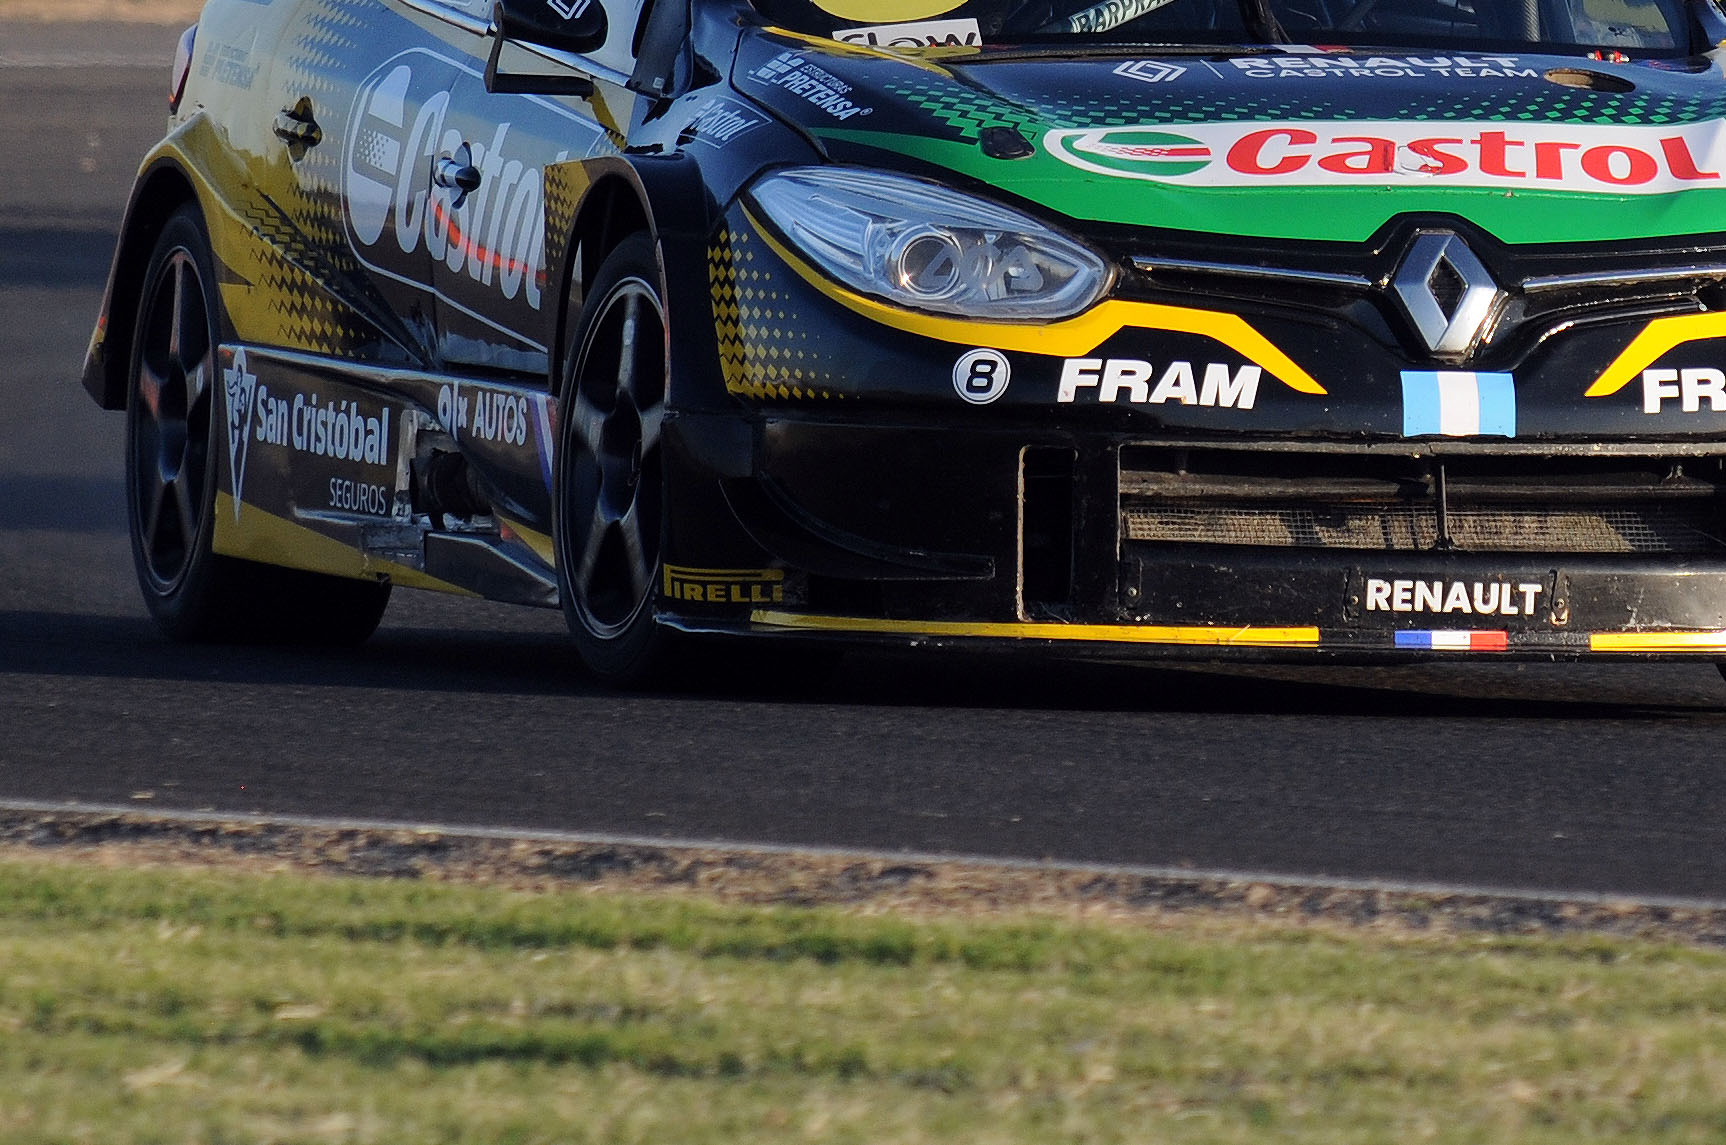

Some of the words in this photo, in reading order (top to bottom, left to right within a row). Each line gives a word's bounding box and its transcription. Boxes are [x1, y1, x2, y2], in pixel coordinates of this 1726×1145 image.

[1228, 57, 1520, 69] RENAULT
[1245, 68, 1425, 79] CASTROL
[1429, 68, 1539, 79] TEAM
[1226, 128, 1720, 185] Castrol
[965, 359, 998, 394] 8
[1057, 359, 1262, 410] FRAM
[255, 384, 288, 446] San
[291, 392, 390, 466] Cristóbal
[471, 390, 528, 447] AUTOS
[329, 476, 386, 516] SEGUROS
[663, 562, 785, 603] PIRELLI
[1366, 579, 1542, 616] RENAULT
